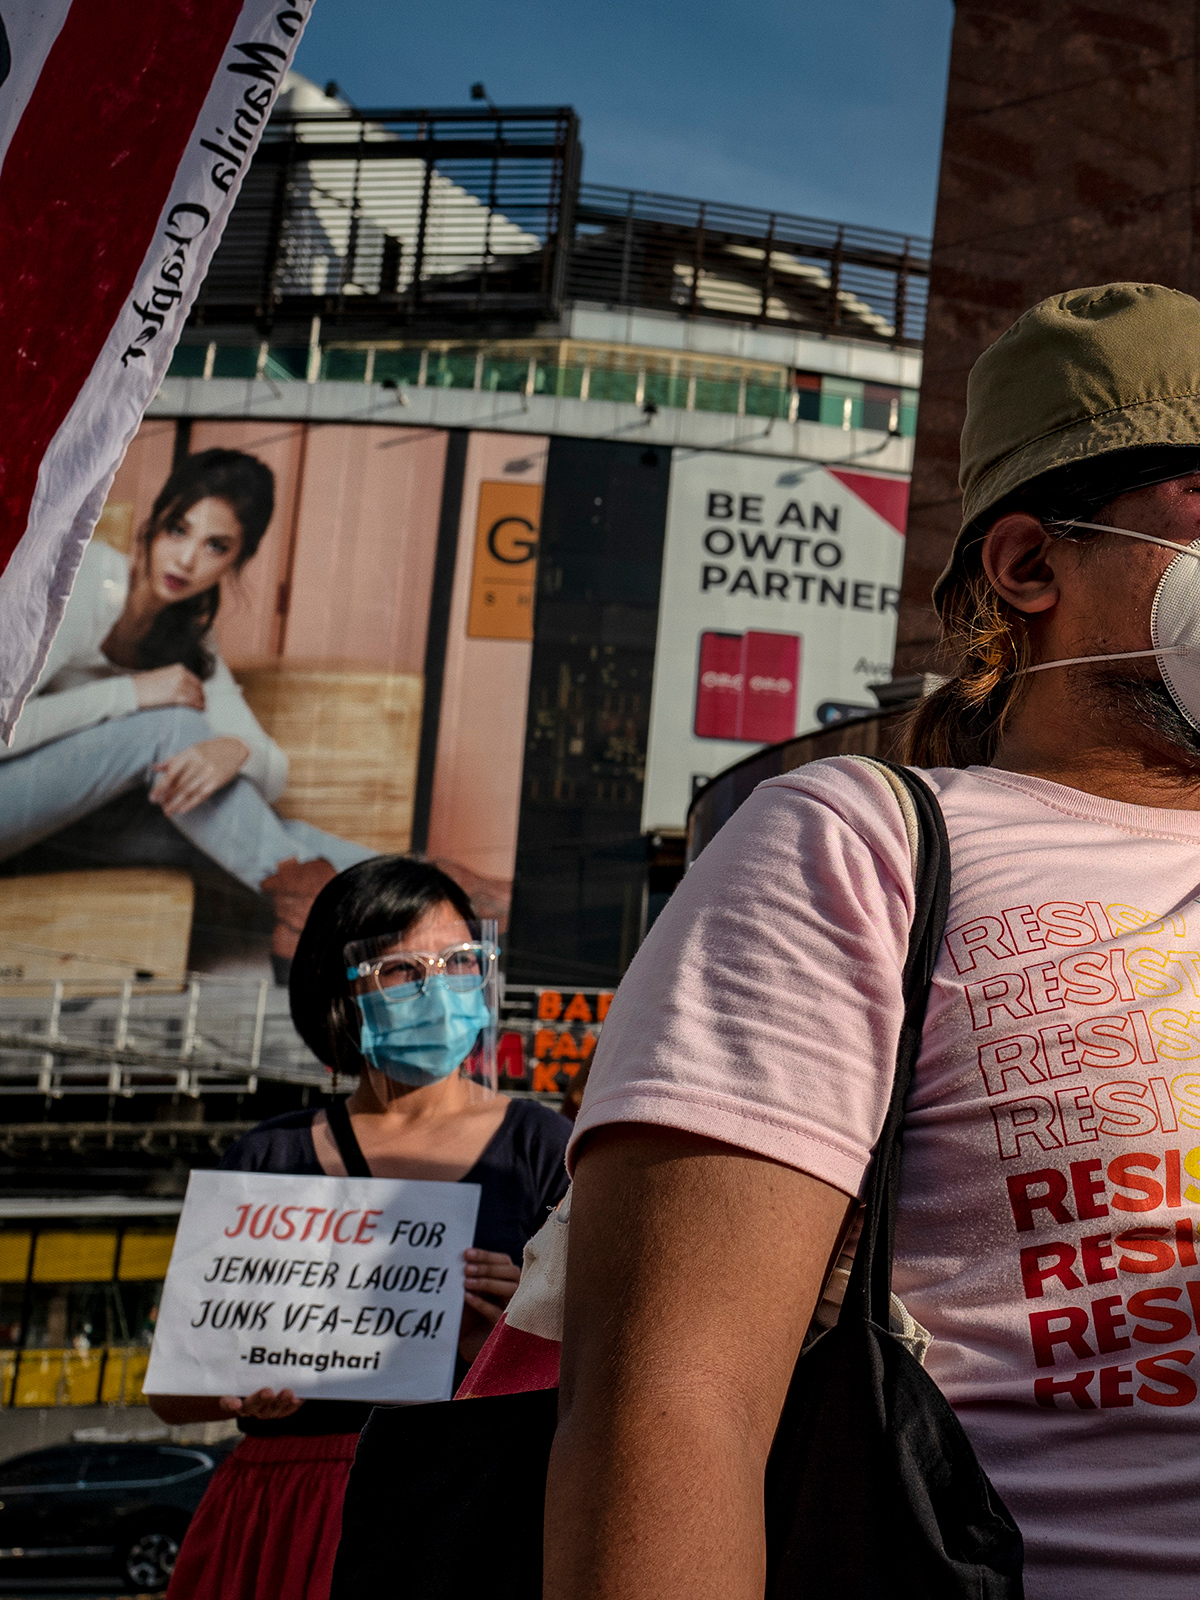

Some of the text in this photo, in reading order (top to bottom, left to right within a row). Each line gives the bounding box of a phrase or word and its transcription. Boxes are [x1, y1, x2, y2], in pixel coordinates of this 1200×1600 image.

[706, 491, 840, 531] BE AN
[704, 530, 843, 569] OWTO
[946, 901, 1186, 976] RESIST
[225, 1204, 446, 1248] JUSTICE FOR
[203, 1256, 448, 1294] JENNIFER LAUDE!
[190, 1299, 444, 1339] JUNK VFA-EDCA!
[240, 1347, 380, 1374] -Bahaghari
